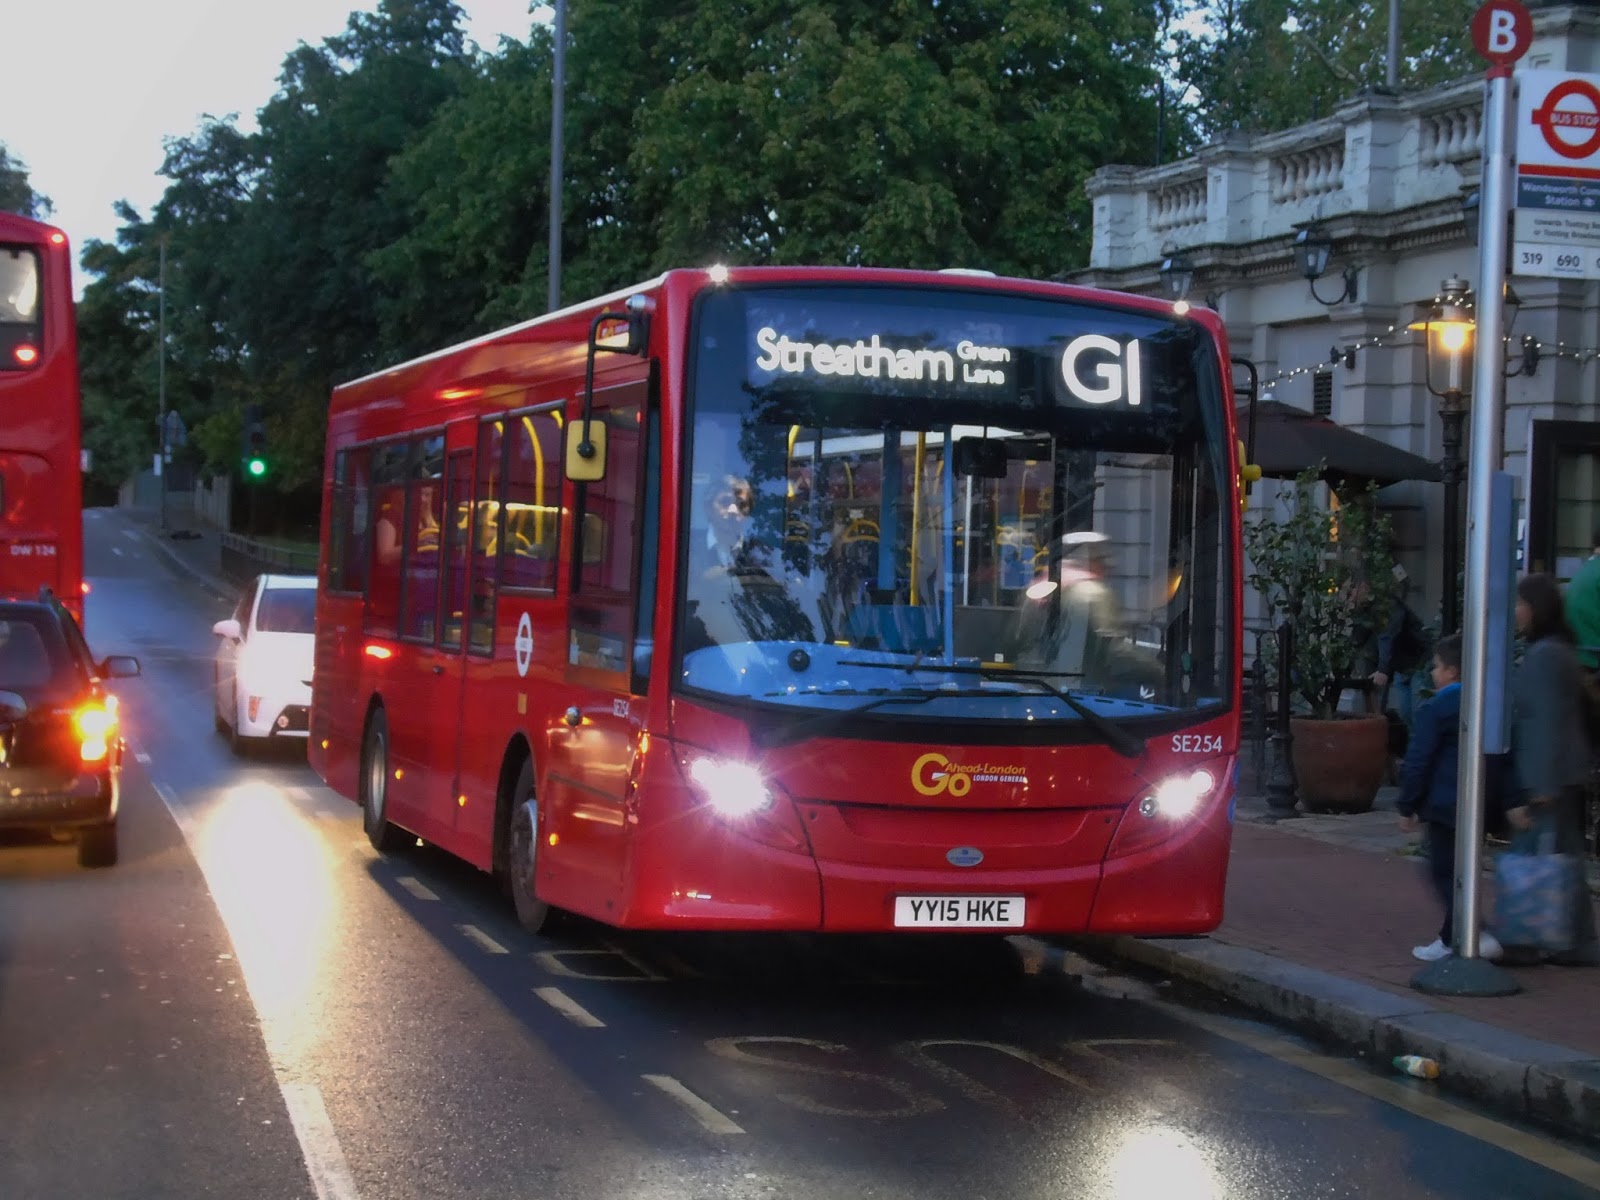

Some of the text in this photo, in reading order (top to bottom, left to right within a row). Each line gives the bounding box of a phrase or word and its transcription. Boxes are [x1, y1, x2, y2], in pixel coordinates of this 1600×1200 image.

[1489, 9, 1517, 53] B
[1550, 112, 1600, 127] BUS STOP
[1522, 252, 1543, 265] 319
[1557, 254, 1581, 268] 690
[756, 327, 954, 382] Streatham
[956, 340, 1011, 362] Green
[963, 363, 1006, 384] Lane
[10, 545, 33, 556] DW
[1171, 734, 1223, 753] SE254
[911, 752, 972, 798] Go
[973, 774, 998, 783] LONDON
[910, 899, 1010, 922] YY15 HKE
